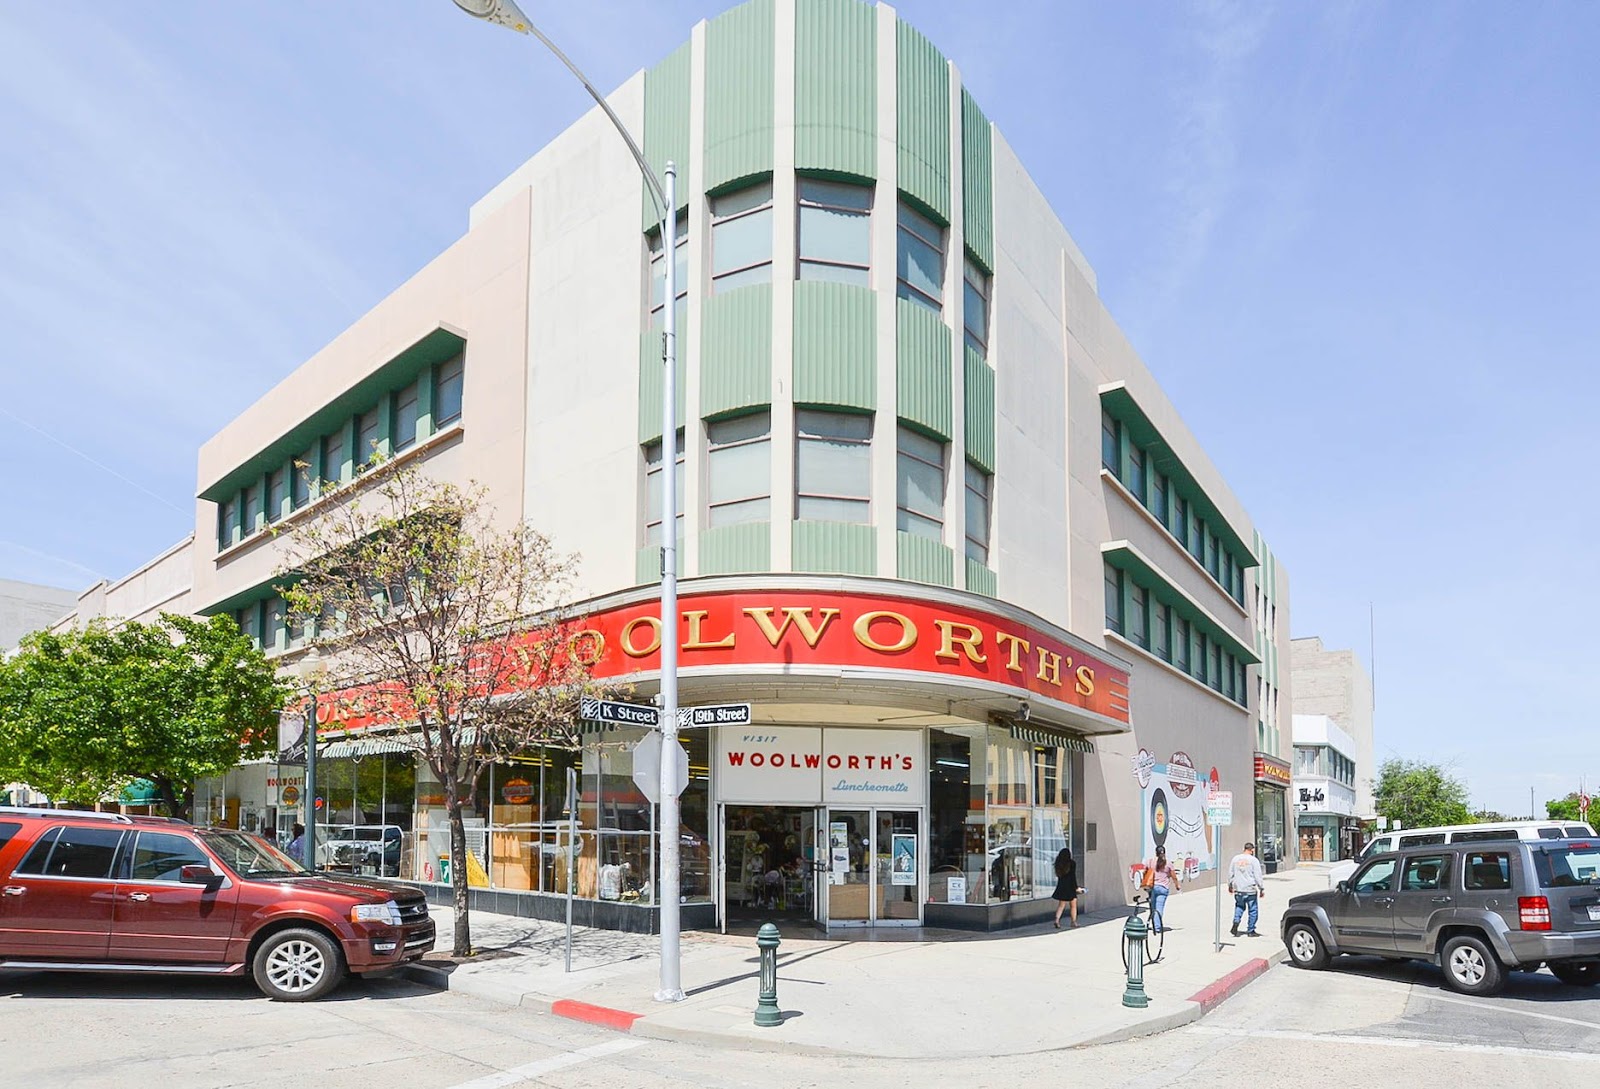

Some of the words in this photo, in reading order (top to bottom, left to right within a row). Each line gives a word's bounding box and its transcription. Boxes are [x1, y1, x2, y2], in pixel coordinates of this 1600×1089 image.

[513, 606, 1096, 698] WOOLWORTH'S
[602, 705, 613, 718] K
[617, 707, 657, 723] Street
[694, 709, 714, 723] 19th
[716, 706, 747, 722] Street
[743, 735, 777, 743] VISIT
[728, 751, 913, 771] WOOLWORTH'S
[831, 779, 909, 793] Luncheonette
